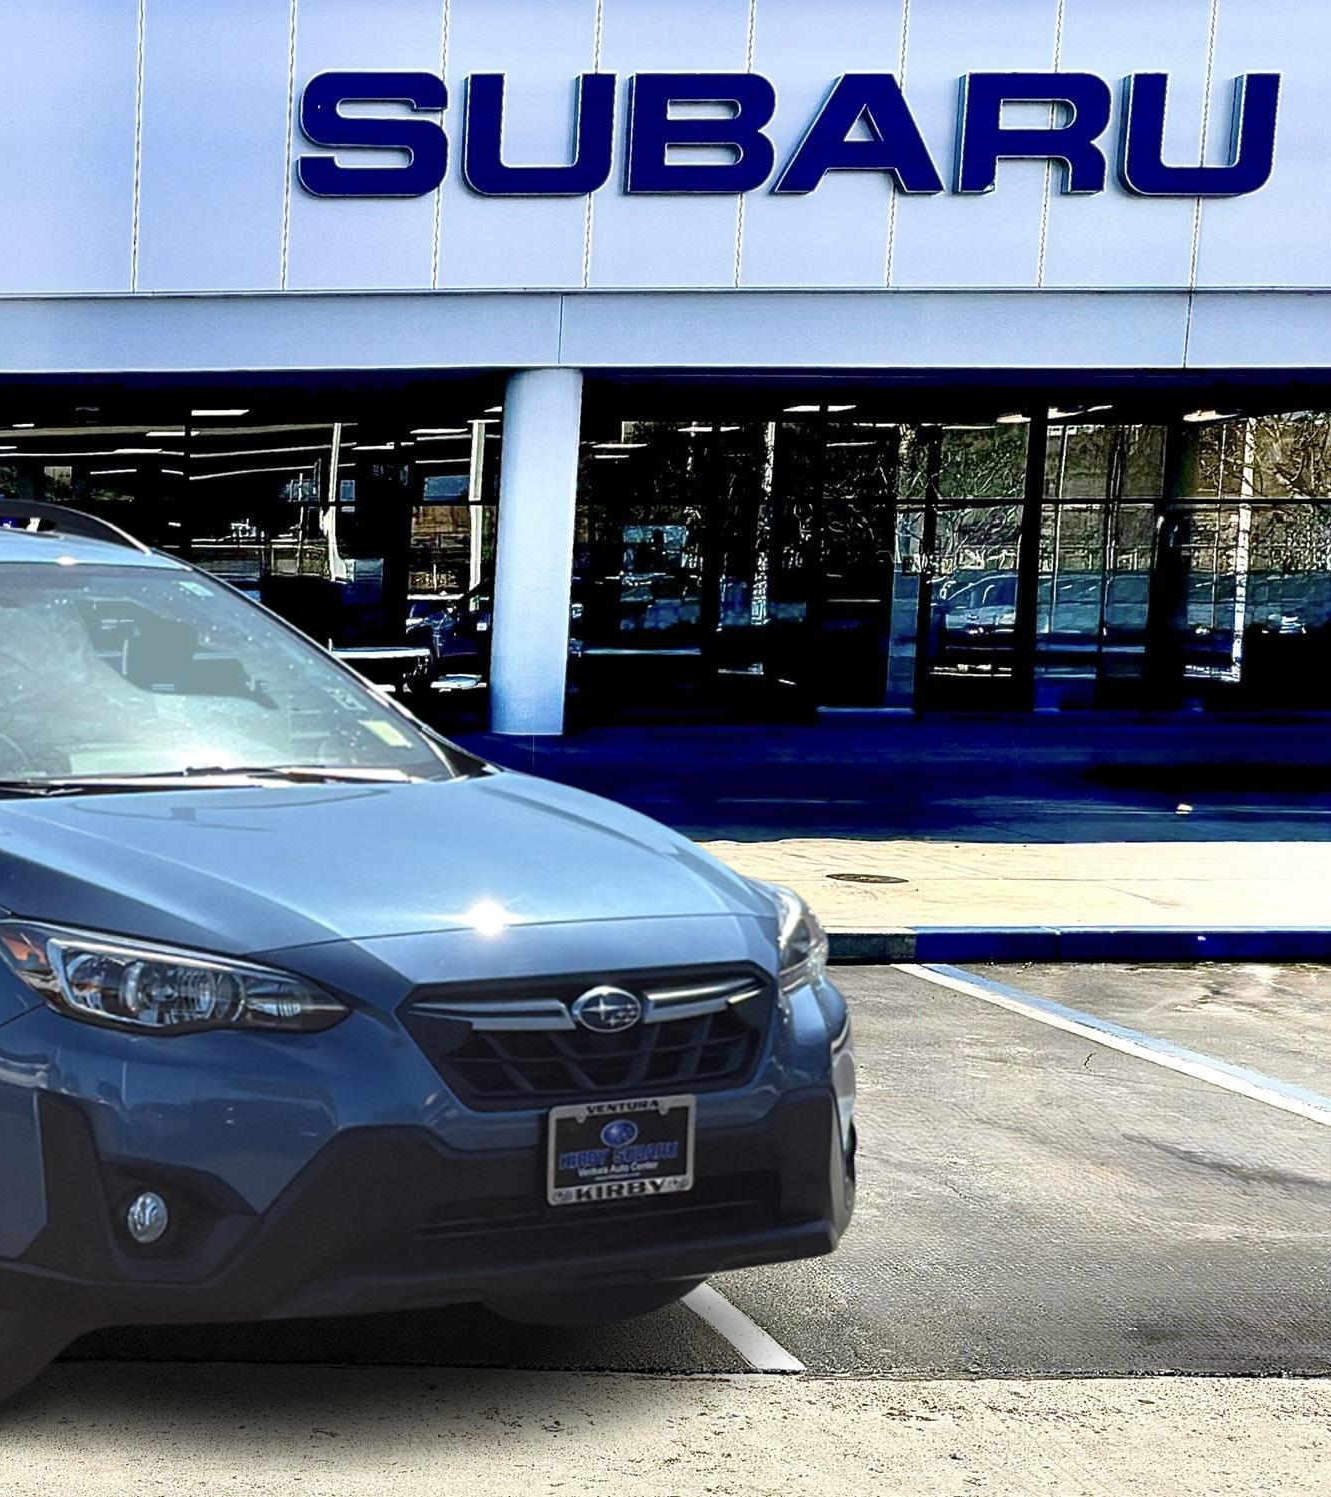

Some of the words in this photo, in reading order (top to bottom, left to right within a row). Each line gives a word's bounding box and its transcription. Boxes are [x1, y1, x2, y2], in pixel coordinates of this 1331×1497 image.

[296, 70, 1281, 198] SUBARU
[587, 1100, 658, 1113] VENTURA
[559, 1148, 611, 1170] KIRBY
[613, 1142, 679, 1163] SUBARU
[577, 1166, 608, 1178] Ventura
[610, 1163, 629, 1173] Auto
[630, 1161, 659, 1172] Center
[576, 1180, 664, 1200] KIRBY
